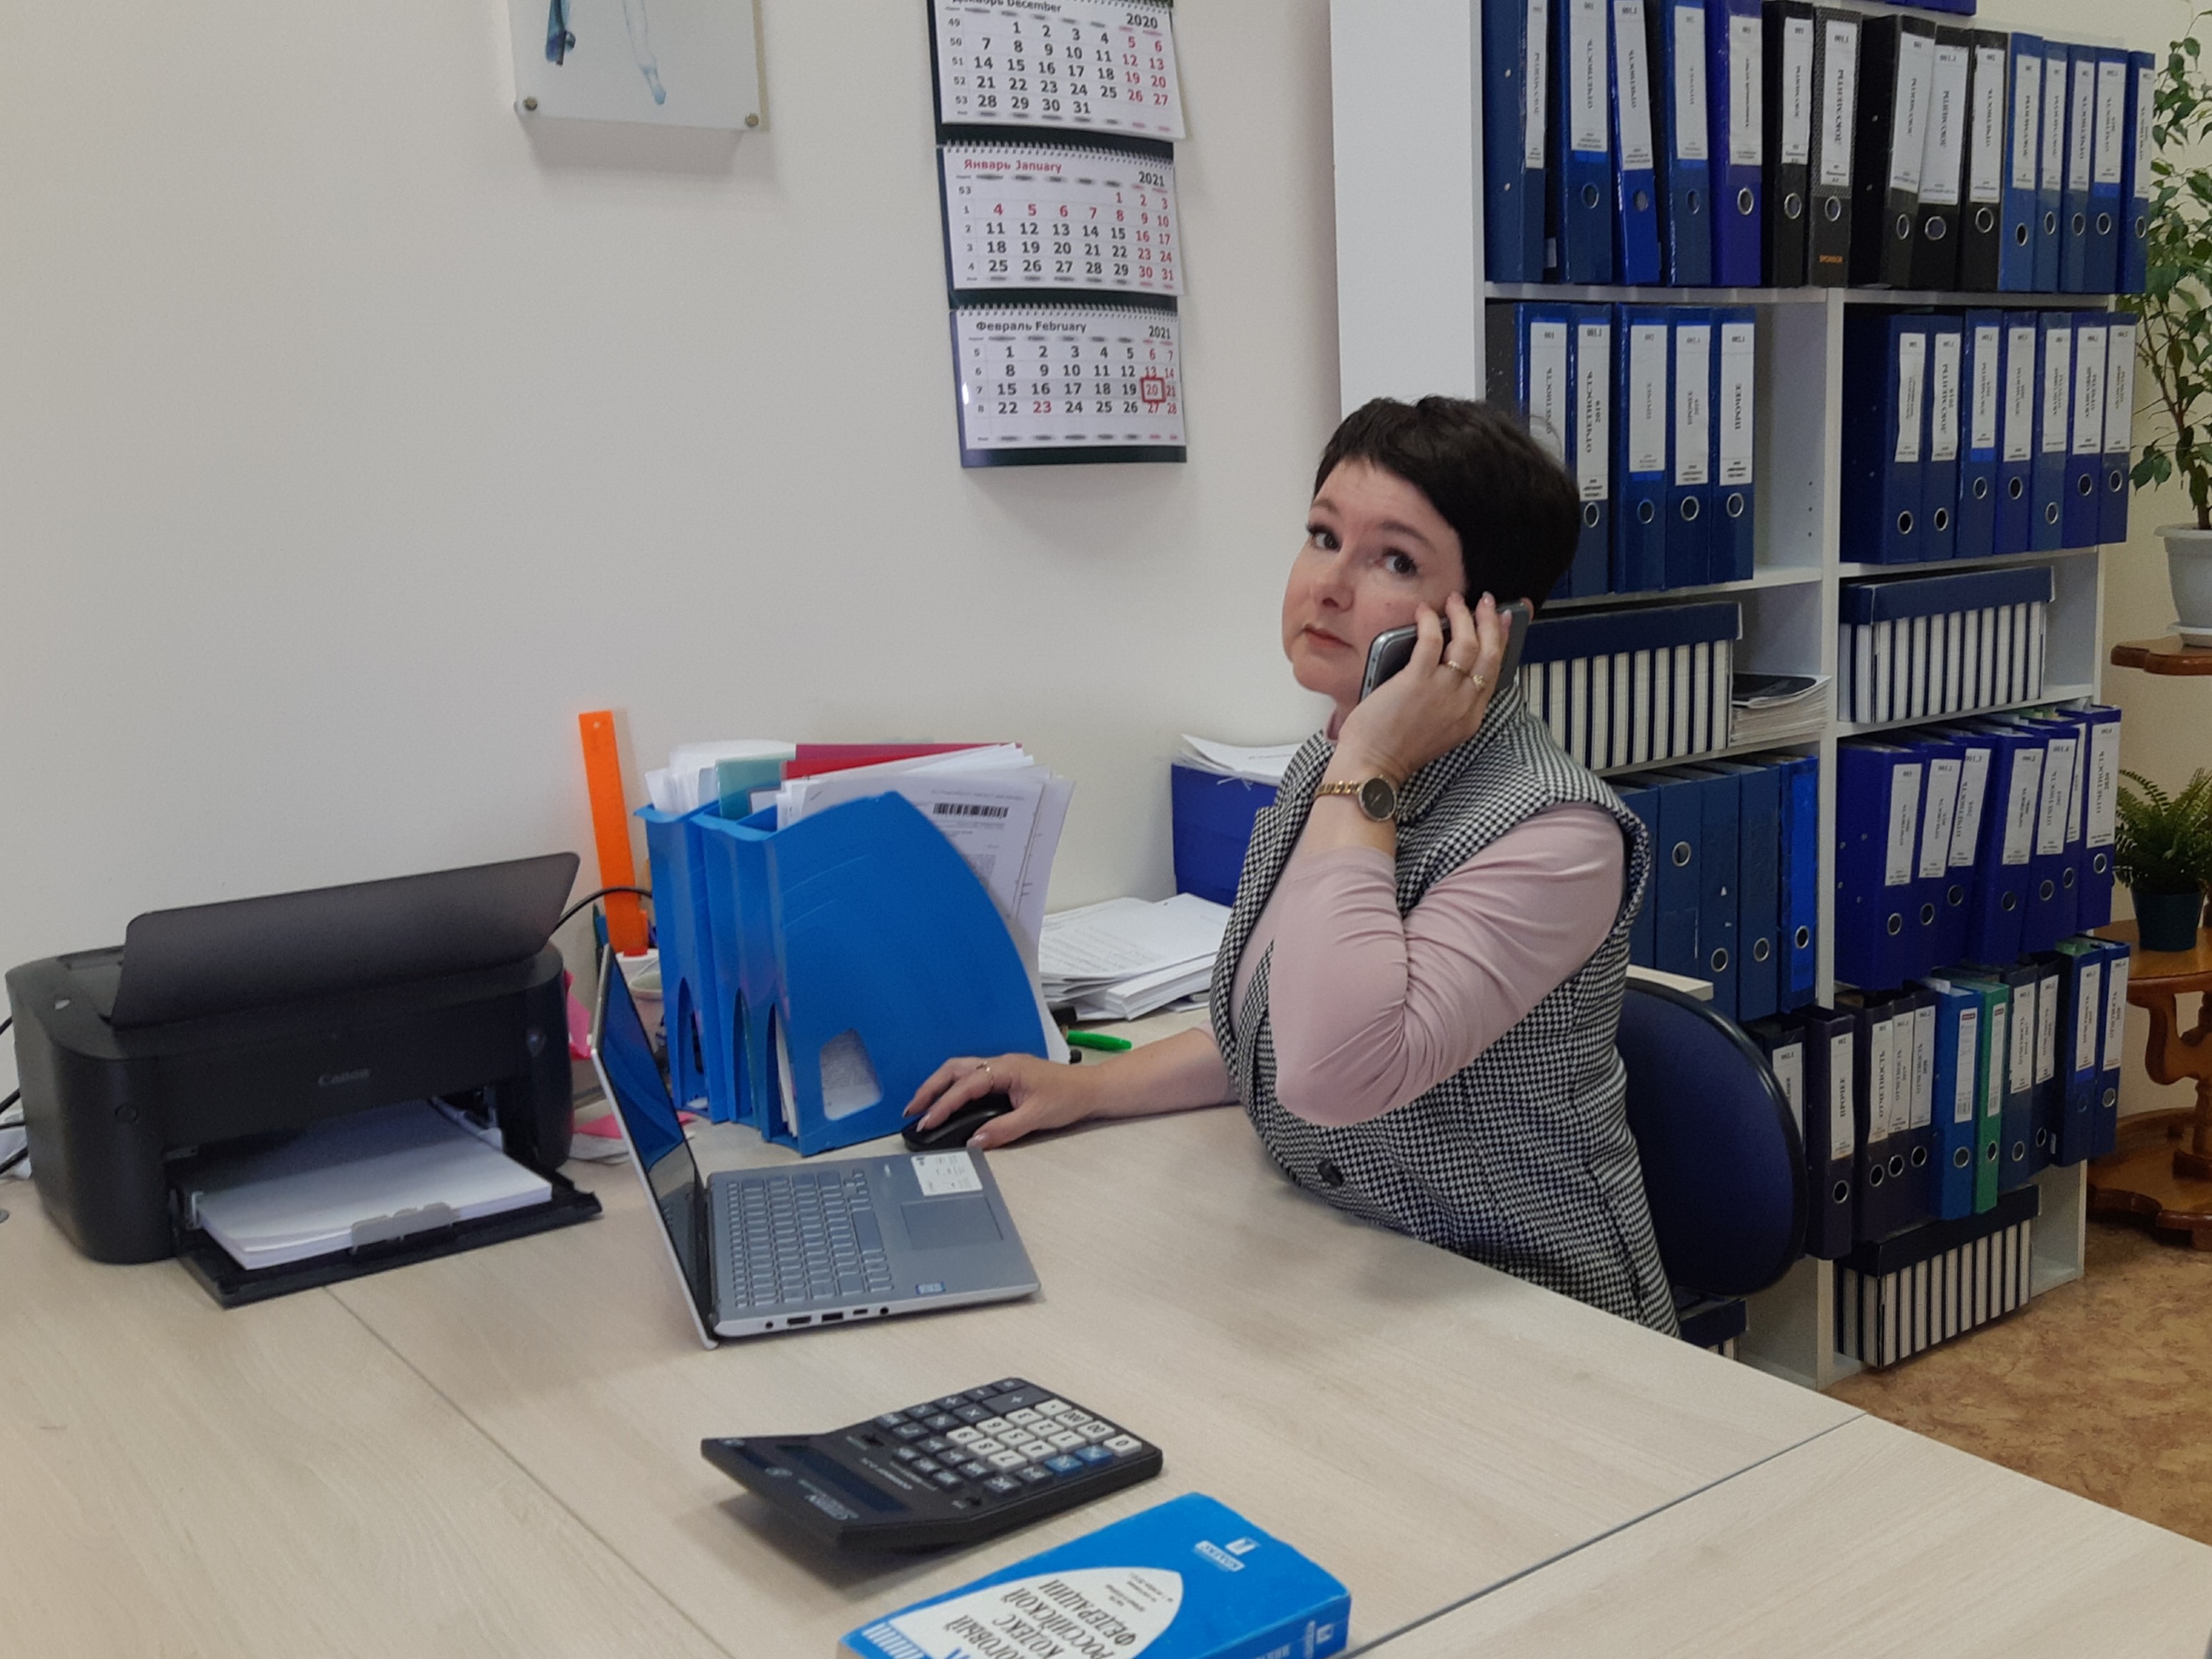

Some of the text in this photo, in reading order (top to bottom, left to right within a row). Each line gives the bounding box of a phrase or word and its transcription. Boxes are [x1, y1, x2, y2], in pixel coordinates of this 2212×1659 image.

[1006, 0, 1062, 13] December
[1126, 13, 1158, 30] 2020
[948, 18, 1162, 52] 49 1 2 3 4 5 6
[950, 37, 1164, 71] 50 7 8 9 10 11 12 13
[952, 56, 1166, 89] 51 14 15 16 17 18 19 20
[954, 76, 1168, 106] 52 21 22 23 24 25 26 27
[955, 94, 1091, 114] 53 28 29 30 31
[964, 159, 1062, 174] Январь January
[1139, 171, 1164, 187] 2021
[958, 186, 1168, 210] 53 1 2 3
[964, 203, 1169, 228] 1 4 5 6 7 8 9 10
[965, 222, 1171, 245] 2 11 12 13 14 15 16 17
[967, 241, 1172, 262] 3 18 19 20 21 22 23 24
[988, 260, 1008, 272] 25
[1023, 260, 1041, 272] 26
[1056, 260, 1073, 273] 27
[1086, 262, 1102, 275] 28
[1114, 263, 1129, 276] 29
[1139, 265, 1153, 278] 30
[1161, 267, 1174, 281] 31
[976, 321, 1086, 333] Февраль February
[1149, 325, 1171, 340] 2021
[1006, 345, 1174, 362] 1 2 3 4 5 6 7
[1006, 364, 1174, 379] 8 9 10 11 12 13 14
[998, 383, 1176, 398] 15 16 17 18 19 20 21
[1940, 364, 1948, 434] ДОКУМЕНТЫ
[998, 400, 1177, 415] 22 23 24 25 26 27 28
[1957, 781, 1968, 837] ОТЧЕТНОСТЬ
[2045, 771, 2057, 826] ОТЧЕТНОСТЬ
[1063, 1412, 1086, 1424] 000
[1008, 1432, 1023, 1440] 5
[1086, 1424, 1106, 1436] 00
[1001, 1587, 1115, 1659] РОССИЙСКОЙ
[1036, 1578, 1137, 1648] ФЕДЕРАЦИИ
[944, 1615, 1025, 1659] ОГОВЫЙ
[991, 1614, 1065, 1659] КОДЕКС
